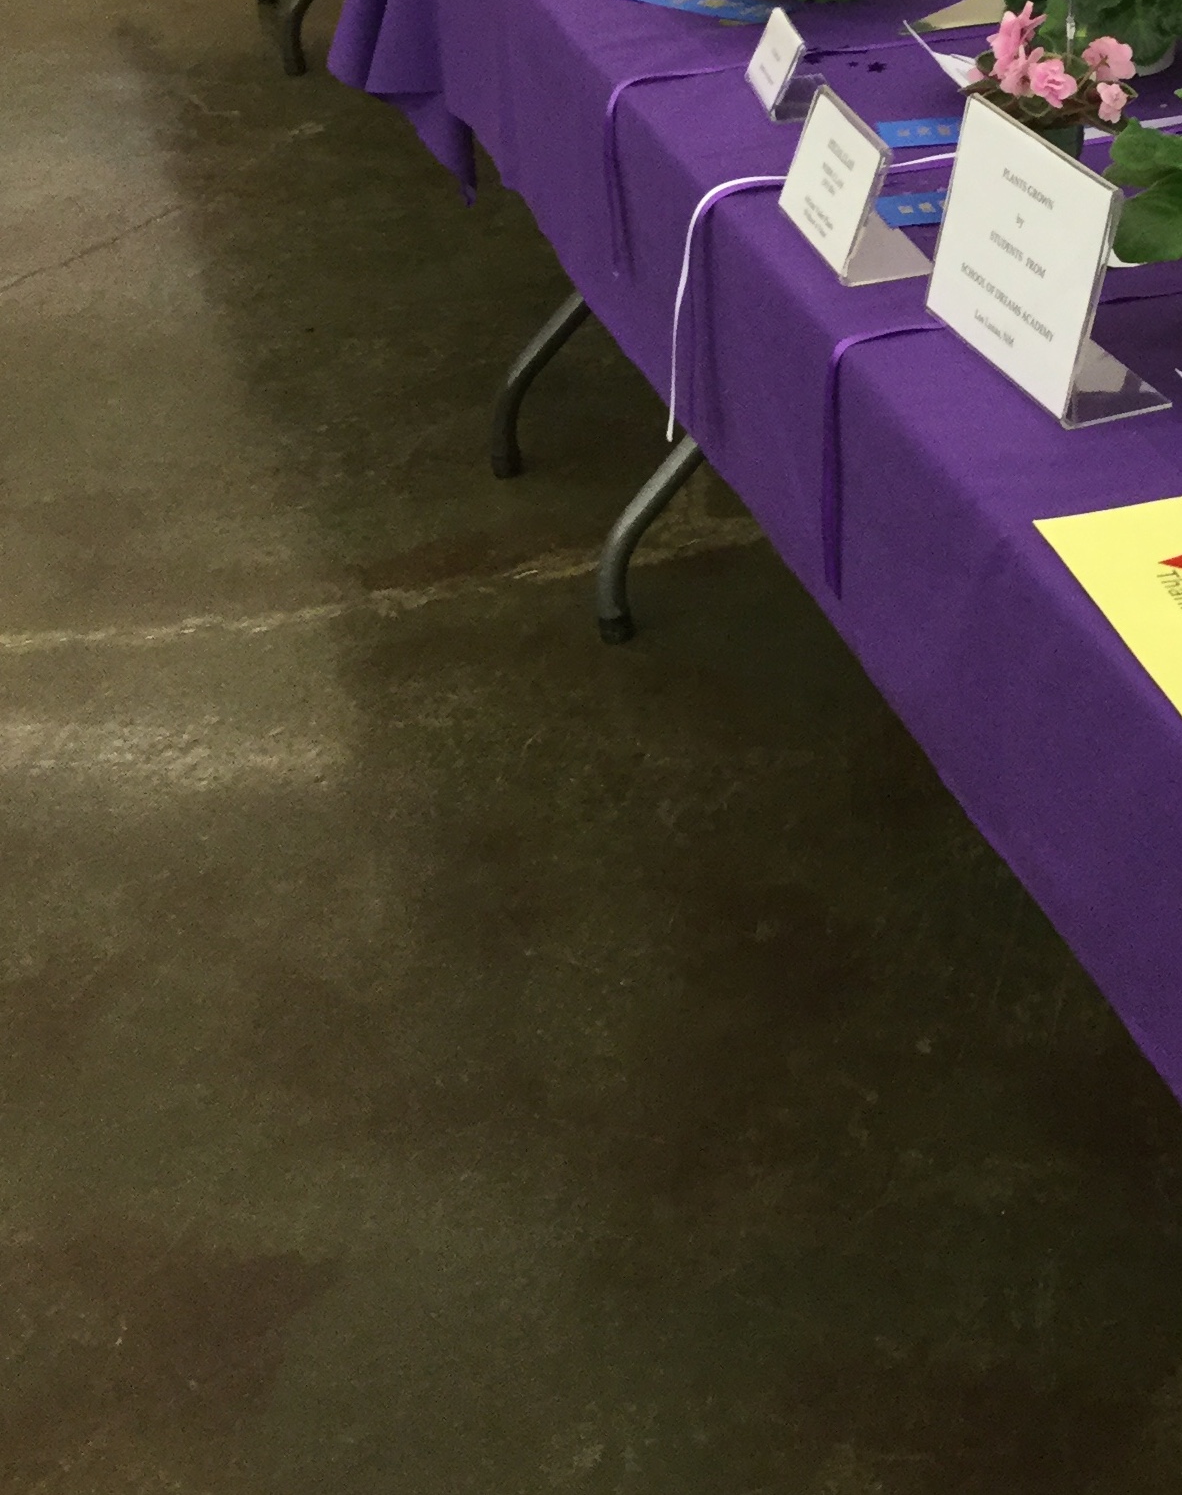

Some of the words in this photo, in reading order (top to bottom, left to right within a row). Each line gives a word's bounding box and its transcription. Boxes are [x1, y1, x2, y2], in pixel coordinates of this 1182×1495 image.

[1003, 168, 1028, 193] PLANTS
[1027, 185, 1055, 211] GROWN
[1015, 213, 1025, 229] by
[989, 230, 1024, 262] STUDENTS
[1025, 256, 1047, 280] FROM
[960, 261, 986, 289] SCHOOL
[986, 281, 996, 296] OF
[994, 287, 1022, 318] DREAMS
[1021, 310, 1054, 344] ACADEMY
